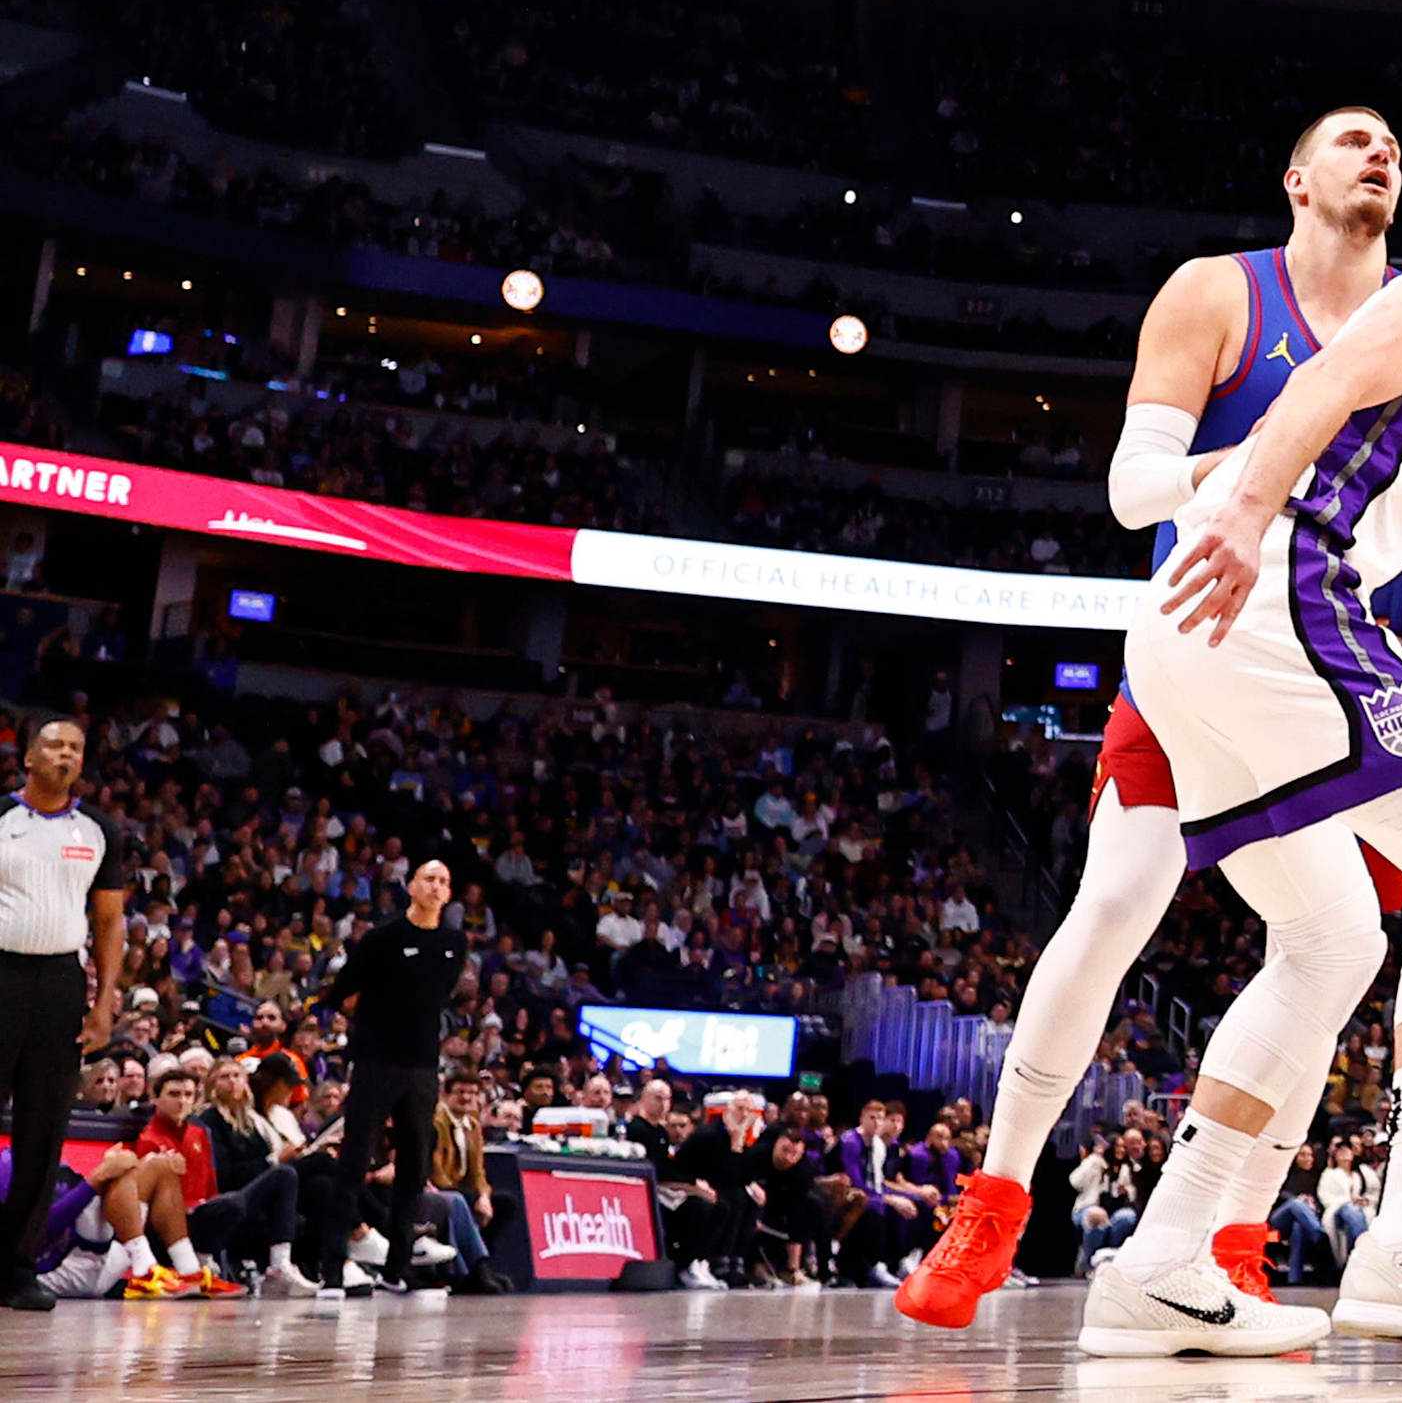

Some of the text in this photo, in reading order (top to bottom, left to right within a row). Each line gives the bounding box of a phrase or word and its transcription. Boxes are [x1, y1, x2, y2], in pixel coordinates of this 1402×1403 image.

[653, 554, 802, 590] OFFICIAL
[819, 571, 940, 603] HEALTH
[953, 584, 1033, 611] CARE
[541, 1192, 640, 1255] uchealth
